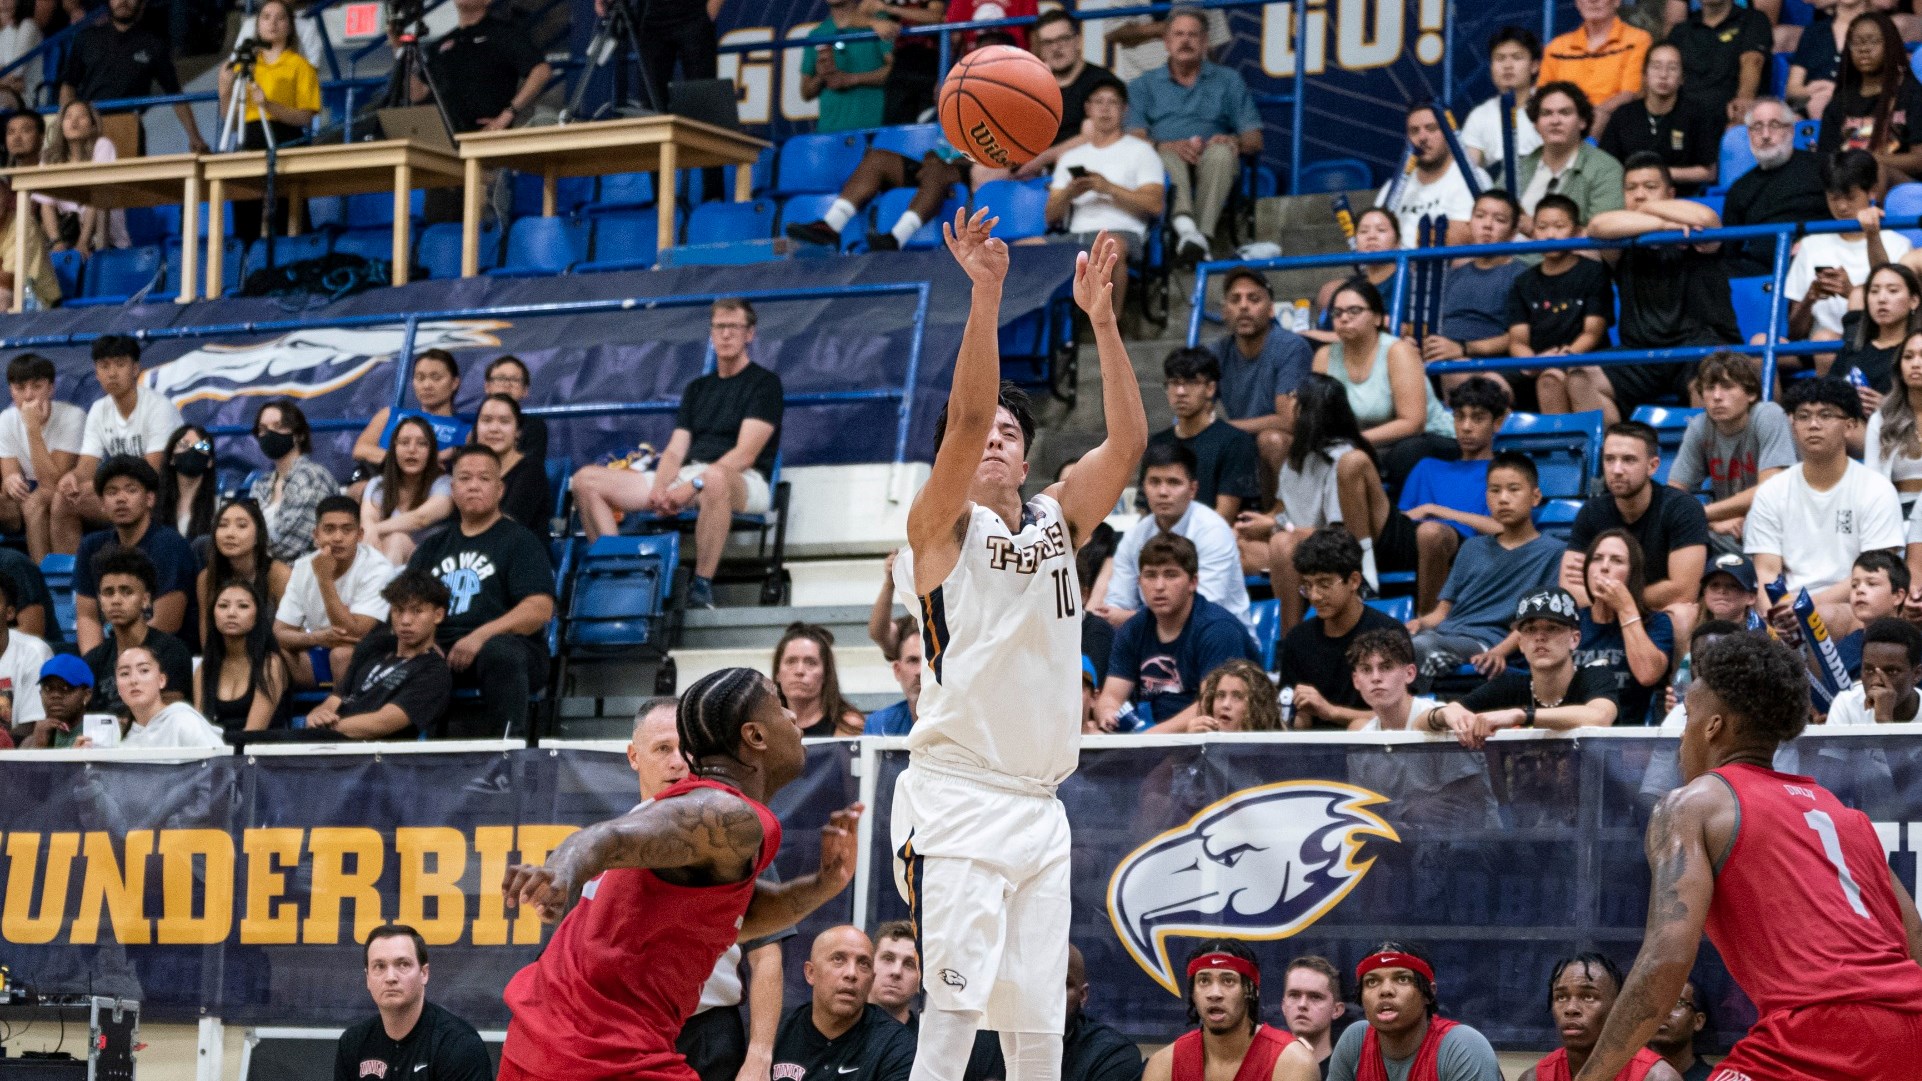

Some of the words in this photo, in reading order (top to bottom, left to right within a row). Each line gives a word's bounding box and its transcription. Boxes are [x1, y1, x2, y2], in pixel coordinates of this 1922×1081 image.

[431, 551, 495, 581] OWER
[1051, 567, 1075, 619] 10
[1803, 808, 1870, 919] 1
[0, 825, 583, 944] UNDERBI
[360, 1059, 388, 1079] UNLV
[773, 1063, 806, 1081] UNLV
